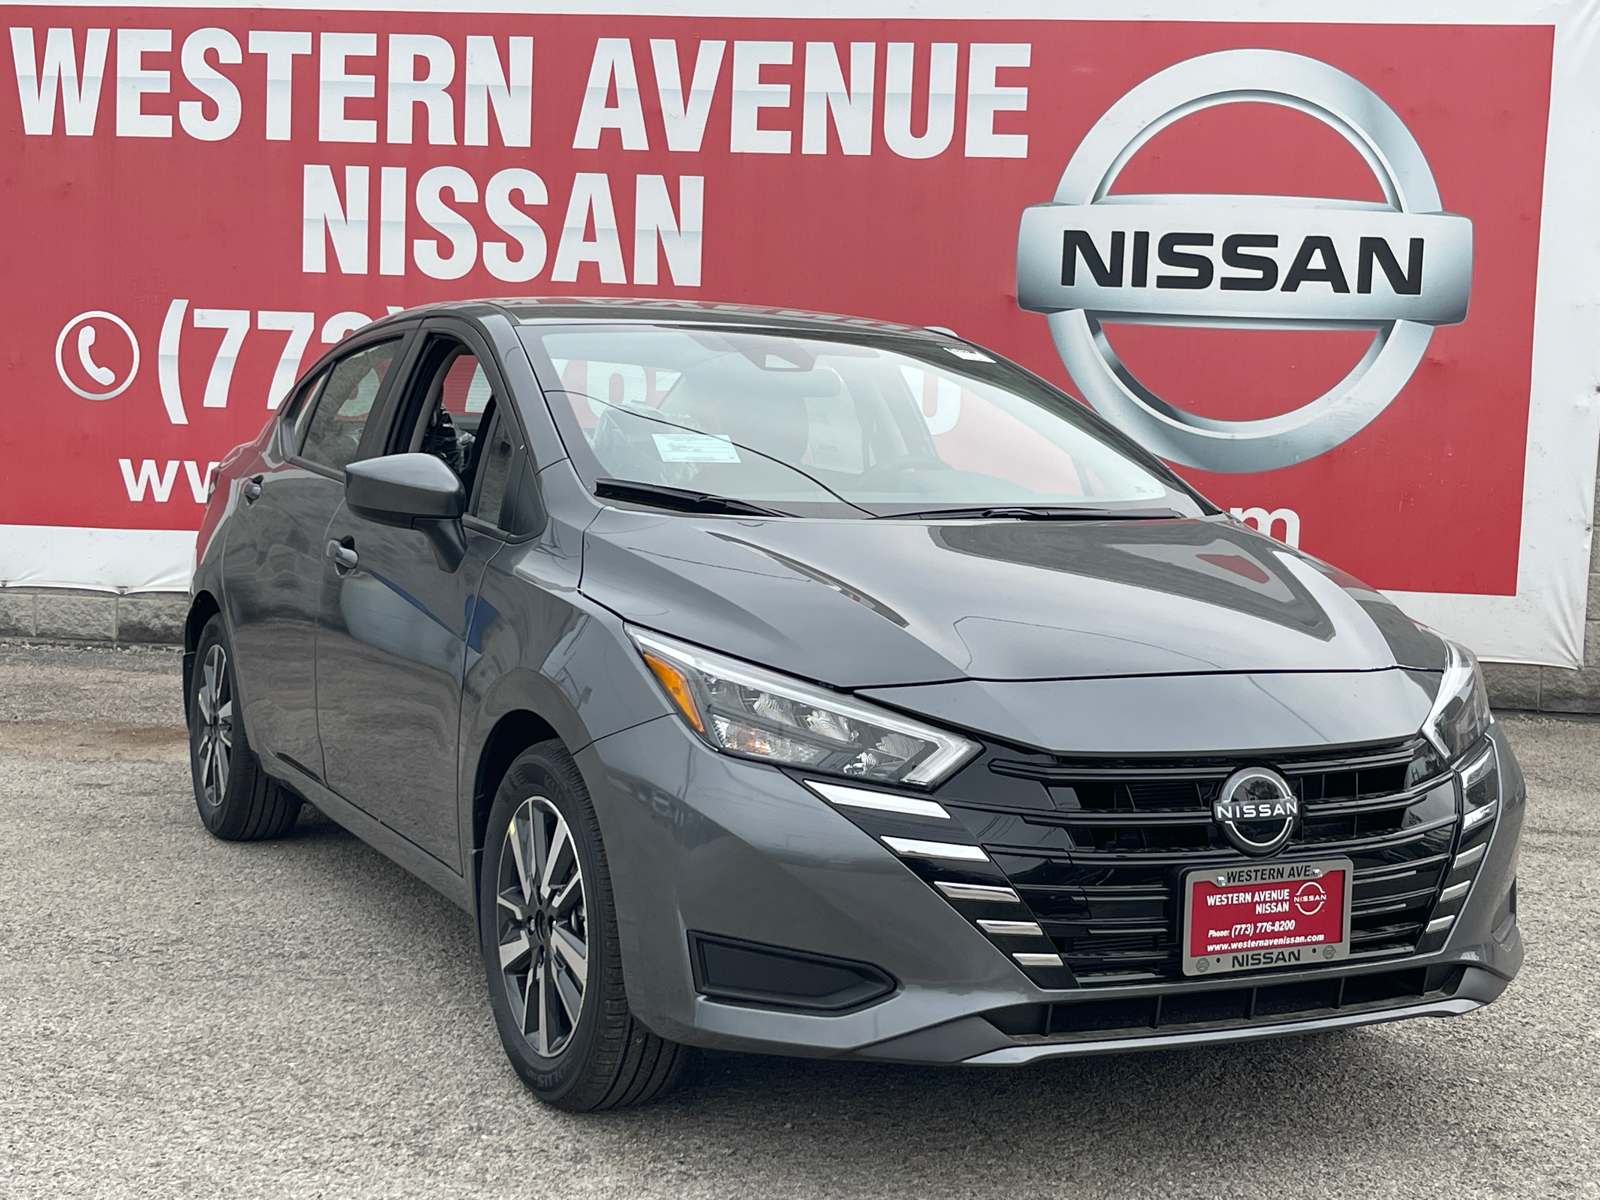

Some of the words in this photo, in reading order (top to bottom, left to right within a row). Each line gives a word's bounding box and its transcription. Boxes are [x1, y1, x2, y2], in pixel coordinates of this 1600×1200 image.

[10, 27, 533, 147] WESTERN
[572, 37, 1032, 160] AVENUE
[302, 164, 704, 287] NISSAN
[1060, 230, 1424, 295] NISSAN
[1216, 801, 1297, 819] NISSAN
[1226, 867, 1284, 884] WESTERN
[1206, 892, 1251, 907] WESTERN
[1254, 889, 1290, 902] AVENUE
[1293, 894, 1327, 903] NISSAN
[1256, 902, 1290, 914] NISSAN
[1208, 930, 1230, 938] Phone:
[1231, 923, 1254, 938] (773)
[1256, 919, 1296, 934] 776-8200
[1207, 934, 1325, 951] www.westernavenissan.com
[1232, 949, 1300, 968] NISSAN
